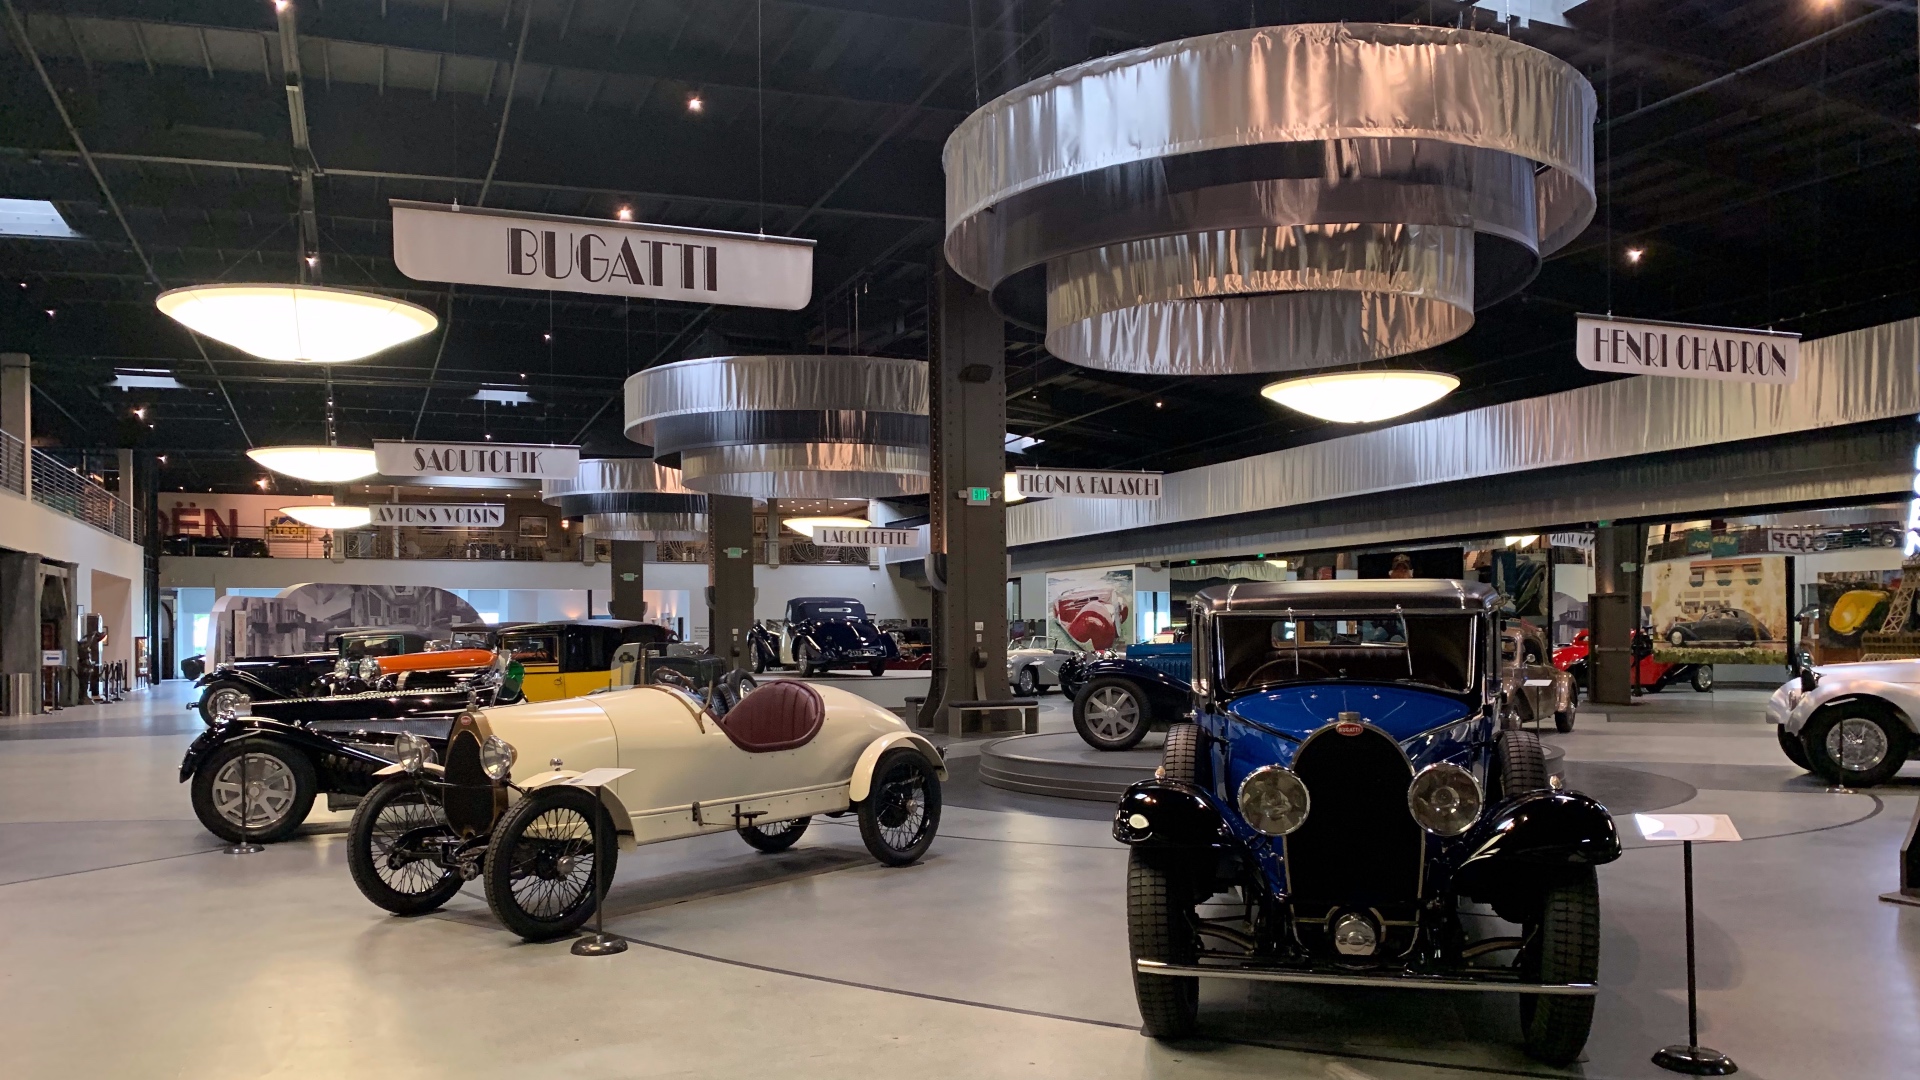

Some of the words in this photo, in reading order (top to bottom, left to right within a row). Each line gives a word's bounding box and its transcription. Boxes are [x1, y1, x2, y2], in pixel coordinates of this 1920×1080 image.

[506, 227, 718, 292] BUGATTI
[1594, 327, 1668, 368] HENRI
[1676, 334, 1786, 377] CHAPRON
[413, 447, 544, 474] SAOUTCHIK
[1020, 474, 1070, 493] FIGONI
[1074, 475, 1085, 494] &
[1090, 476, 1159, 496] FALASCHI
[375, 507, 437, 523] AVIONS
[444, 508, 500, 524] VOISIN
[823, 529, 910, 545] LABOURDETTE
